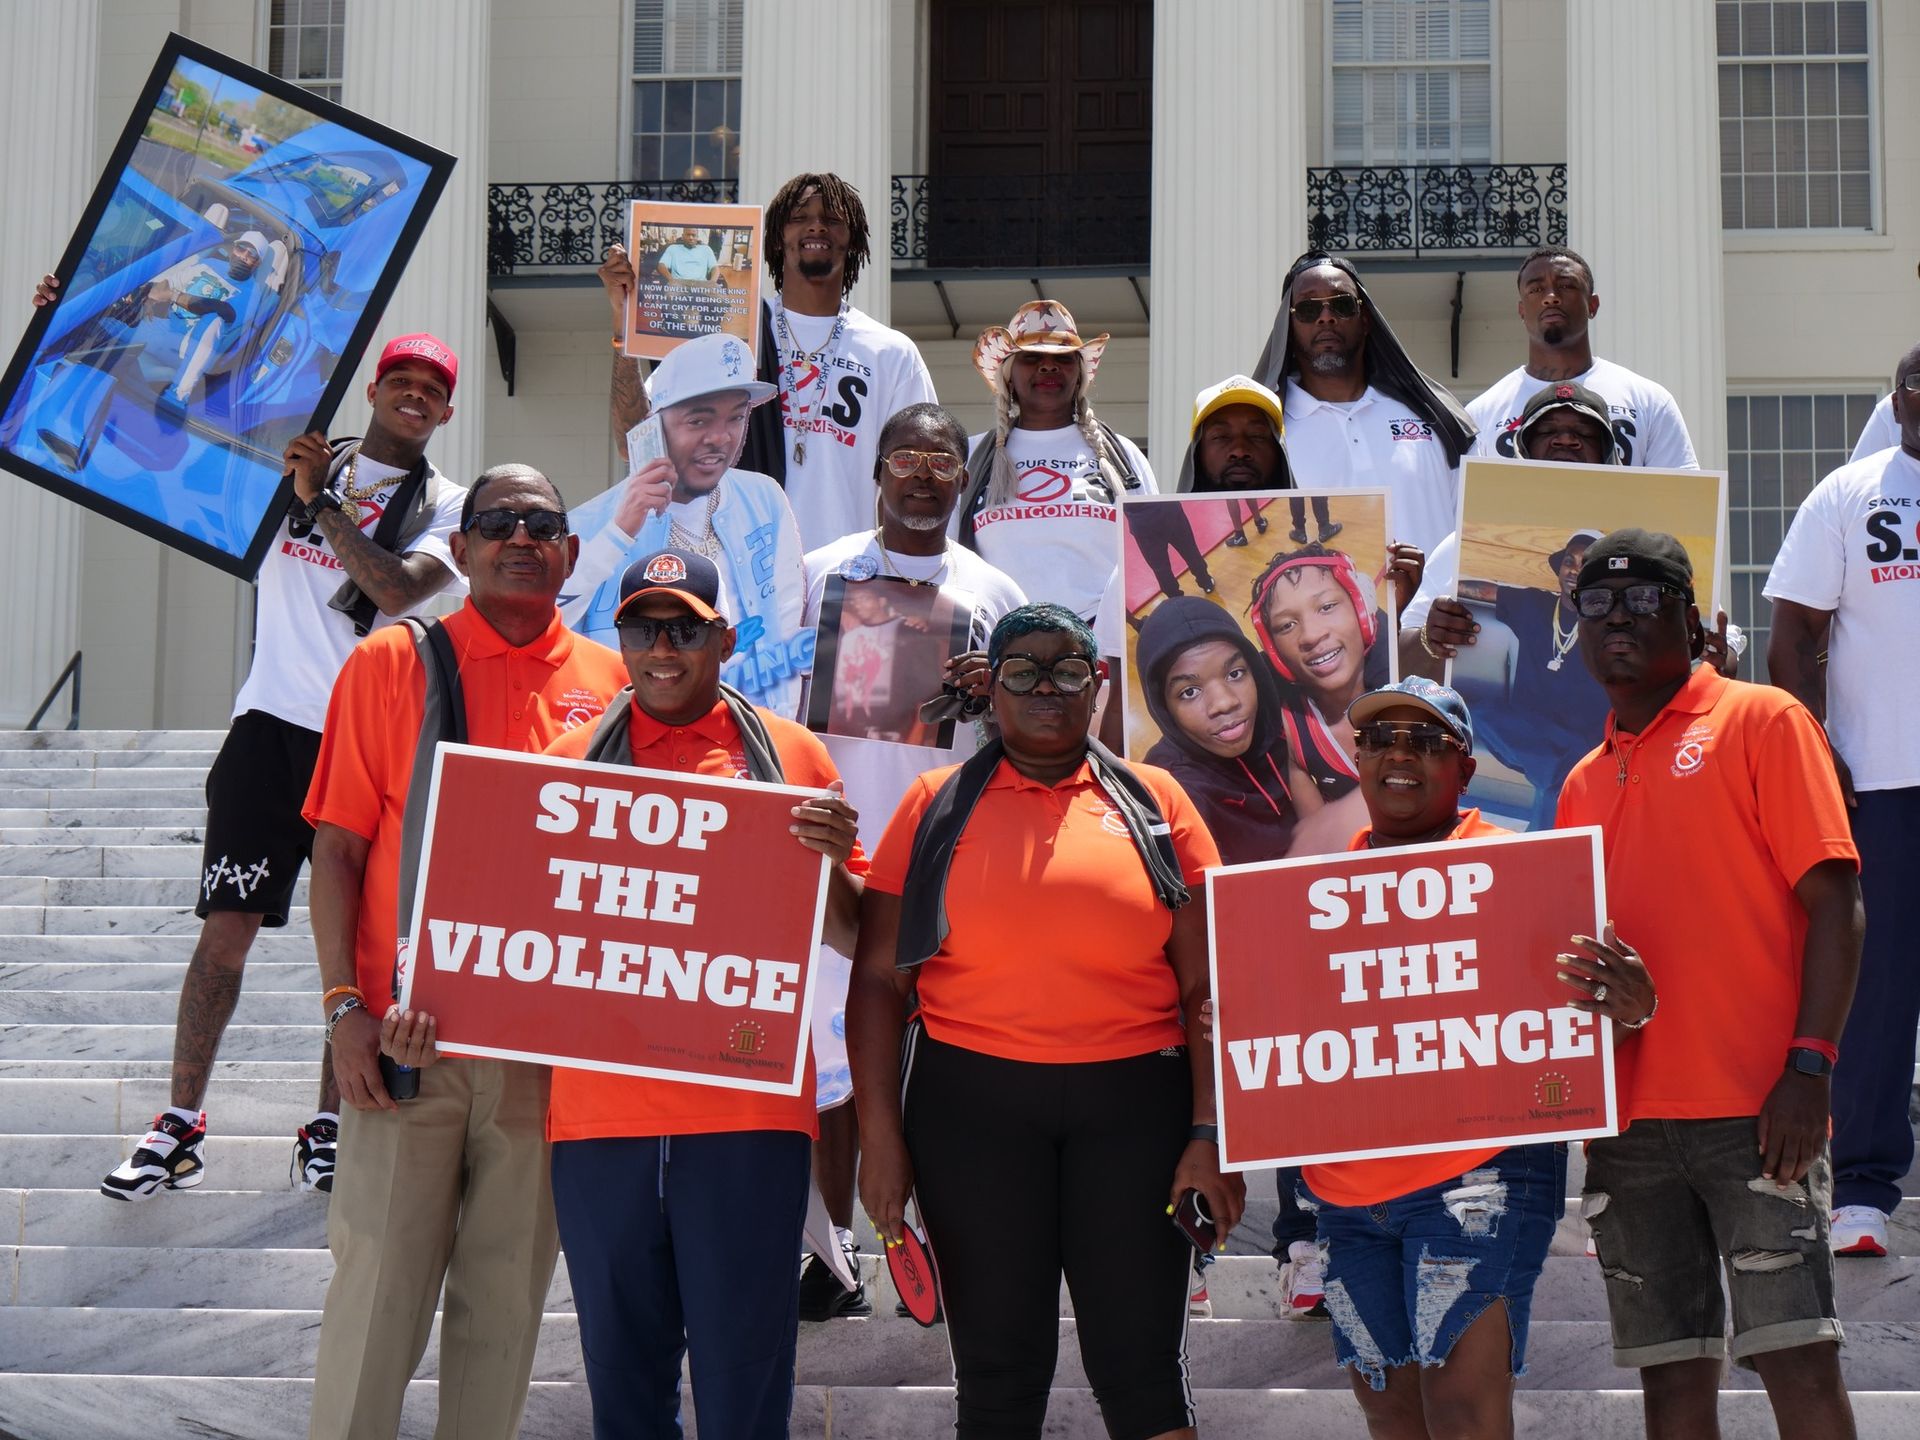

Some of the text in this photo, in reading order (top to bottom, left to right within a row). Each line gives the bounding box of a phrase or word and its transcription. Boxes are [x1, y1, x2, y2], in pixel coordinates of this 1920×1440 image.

[644, 302, 669, 310] CAN'T
[711, 306, 748, 315] JUSTICE
[649, 320, 722, 333] OF THE LIVING
[1015, 459, 1046, 469] OUR
[1868, 498, 1912, 510] SAVE
[975, 505, 1113, 530] MONTGOMERY
[535, 782, 728, 851] STOP
[547, 857, 700, 925] THE
[1308, 862, 1494, 930] STOP
[428, 918, 801, 1014] VIOLENCE
[1328, 938, 1480, 1004] THE
[718, 1050, 786, 1071] Montgomery
[1227, 1006, 1596, 1091] VIOLENCE
[1527, 1106, 1596, 1120] Montgomery
